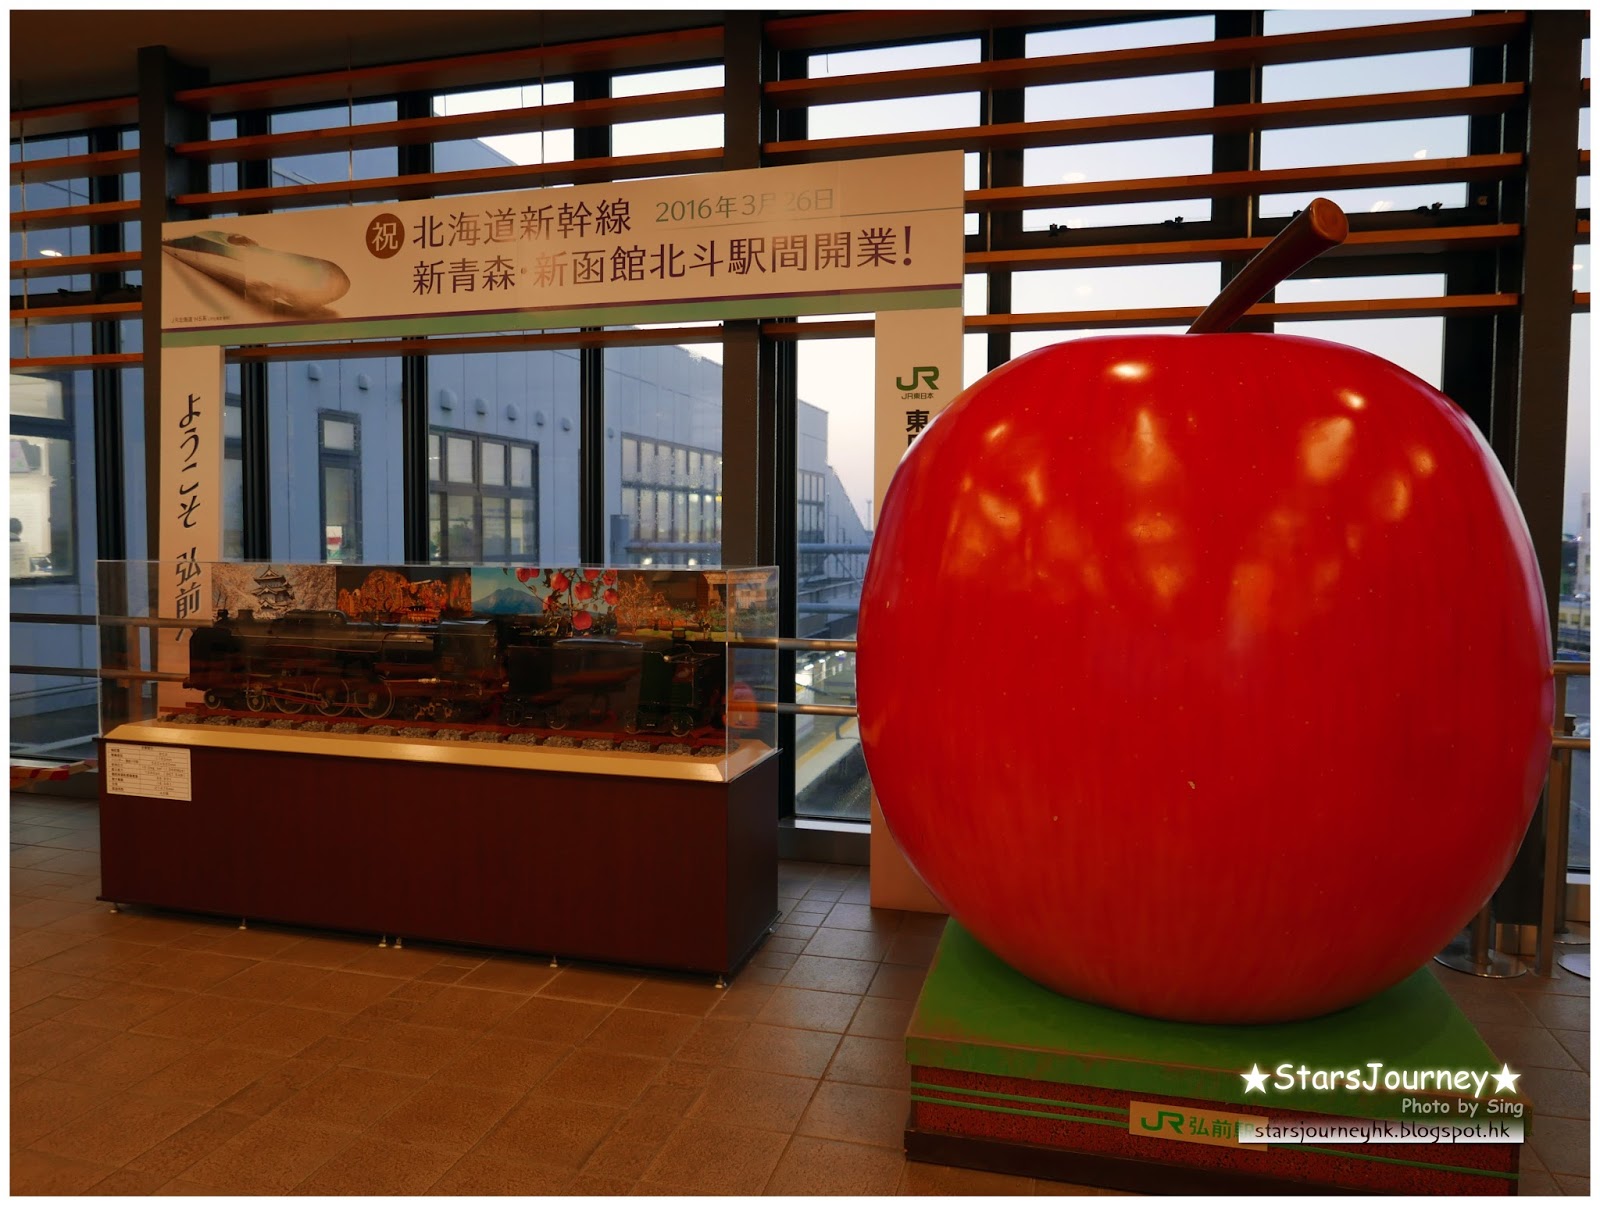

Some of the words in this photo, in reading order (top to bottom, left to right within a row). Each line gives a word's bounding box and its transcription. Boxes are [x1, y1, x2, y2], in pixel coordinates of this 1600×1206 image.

[371, 220, 399, 252] 祝
[412, 197, 632, 249] 北海道新幹線
[896, 366, 939, 391] JR
[901, 392, 934, 400] JR東日本
[906, 409, 930, 447] 東
[178, 393, 201, 528] ようこそ
[1141, 1111, 1185, 1135] JR
